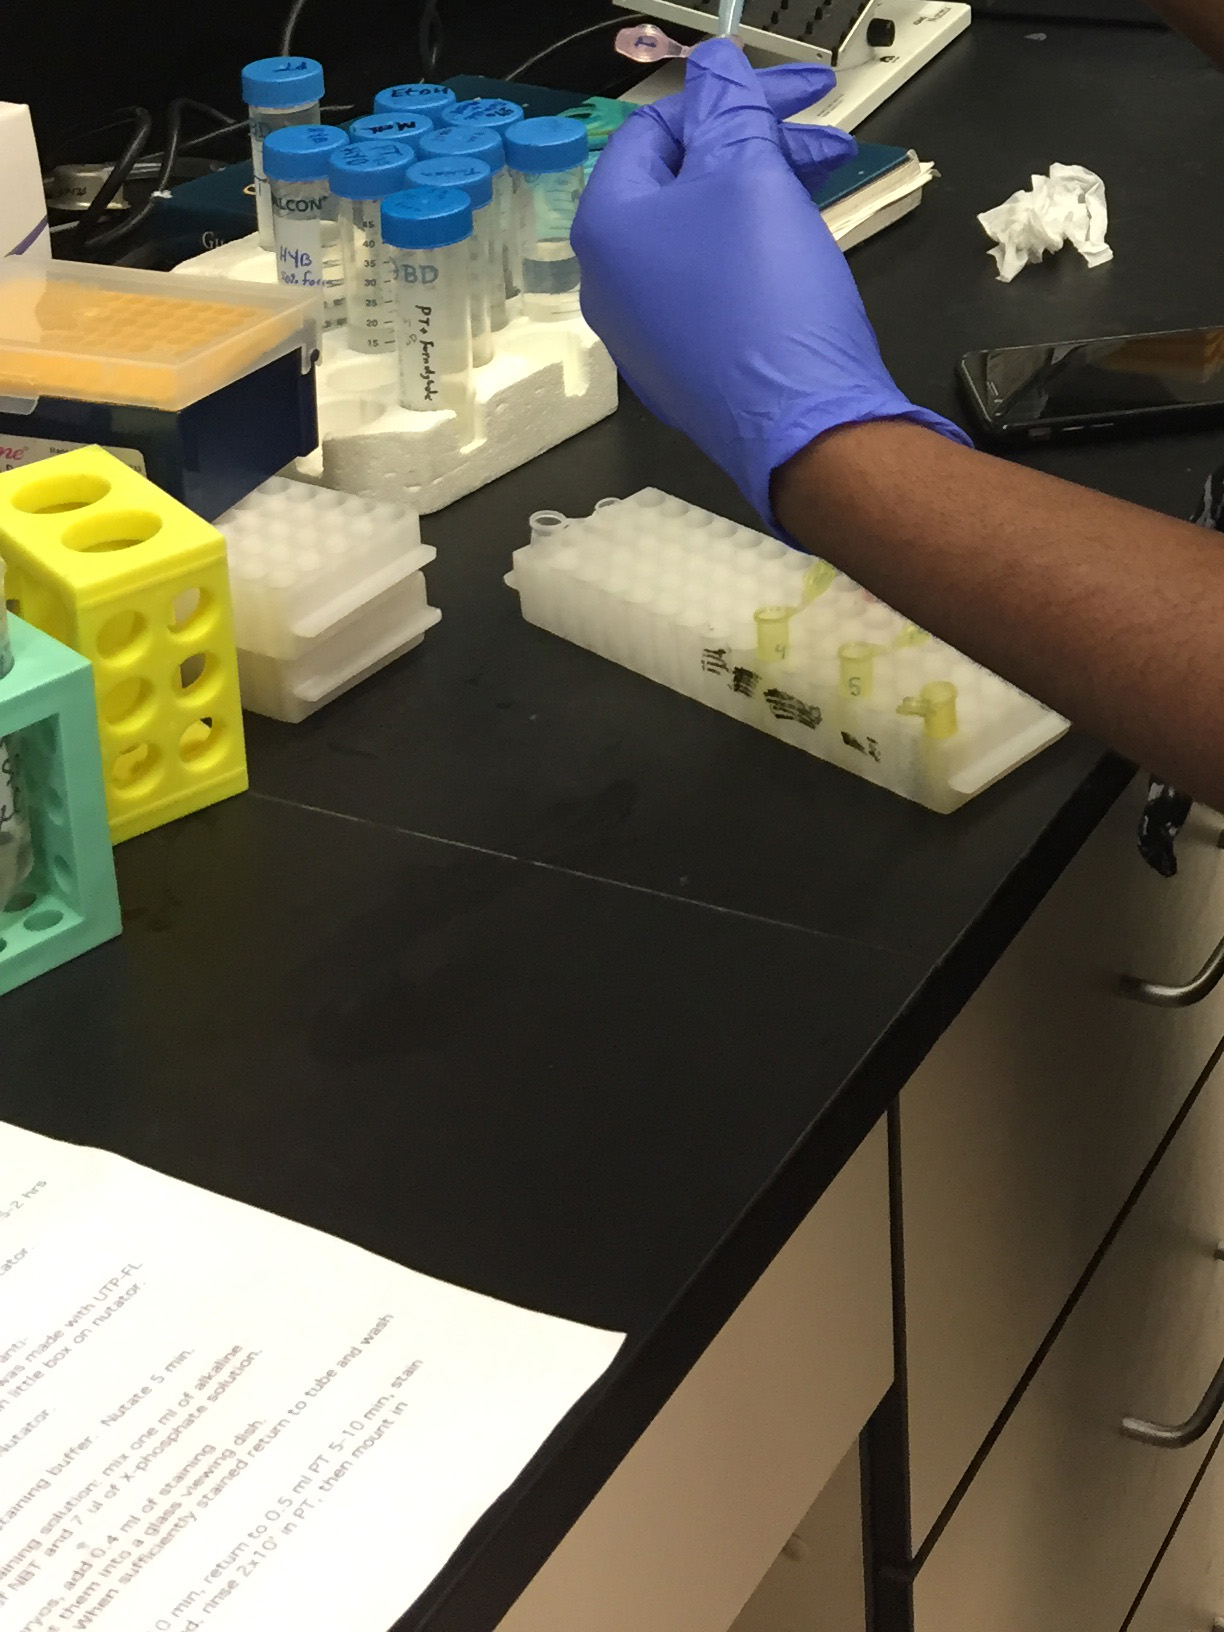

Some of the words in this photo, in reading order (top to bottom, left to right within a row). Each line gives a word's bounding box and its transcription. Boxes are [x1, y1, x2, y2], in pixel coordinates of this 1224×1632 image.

[280, 246, 312, 268] HYB
[363, 240, 376, 248] 40
[364, 260, 376, 268] 35
[402, 264, 439, 284] BD
[364, 279, 377, 287] 30
[365, 299, 378, 307] 25
[366, 319, 379, 327] 20
[367, 339, 379, 347] 15
[21, 1180, 48, 1199] hrs
[0, 1246, 33, 1276] ator.
[24, 1329, 65, 1363] made
[64, 1303, 96, 1328] with
[92, 1263, 144, 1302] UTP-FL
[0, 1398, 11, 1412] n
[7, 1370, 45, 1398] little
[41, 1345, 73, 1369] box
[72, 1328, 93, 1345] on
[91, 1280, 147, 1327] nutator.
[0, 1478, 52, 1532] taining
[45, 1433, 99, 1477] buffer.
[99, 1386, 153, 1427] Nutate
[149, 1374, 166, 1385] 5
[164, 1349, 195, 1373] min.
[0, 1538, 43, 1580] aining
[101, 1452, 130, 1477] mix
[129, 1426, 160, 1451] one
[157, 1408, 178, 1426] ml
[177, 1391, 195, 1408] of
[194, 1344, 244, 1392] alkaline
[6, 1559, 42, 1592] NBT
[43, 1527, 74, 1558] and
[103, 1483, 121, 1499] of
[206, 1350, 263, 1403] solution.
[74, 1588, 120, 1631] When
[117, 1510, 198, 1585] sufficiently
[195, 1457, 249, 1509] stained
[246, 1418, 291, 1458] return
[287, 1400, 308, 1416] to
[303, 1369, 338, 1398] tube
[336, 1345, 363, 1369] and
[359, 1314, 395, 1345] wash
[58, 1581, 101, 1620] them
[98, 1549, 132, 1578] into
[131, 1538, 145, 1548] a
[143, 1501, 183, 1537] glass
[180, 1448, 237, 1497] viewing
[233, 1419, 267, 1447] dish.
[154, 1619, 172, 1632] 0
[170, 1589, 206, 1618] min,
[202, 1541, 250, 1584] return
[247, 1524, 269, 1540] to
[264, 1495, 294, 1522] 0.5
[291, 1474, 313, 1494] ml
[307, 1453, 330, 1474] PT
[327, 1420, 365, 1453] 5-10
[363, 1393, 396, 1421] min,
[390, 1359, 424, 1390] stain
[202, 1579, 240, 1615] rinse
[280, 1522, 298, 1536] in
[292, 1497, 324, 1520] PT,
[317, 1460, 354, 1492] then
[351, 1418, 395, 1459] mount
[391, 1401, 409, 1416] in
[20, 1596, 66, 1632] ryos,
[63, 1560, 94, 1592] add
[89, 1534, 120, 1559] 0.4
[119, 1514, 142, 1533] ml
[141, 1496, 159, 1514] of
[158, 1443, 217, 1496] staining
